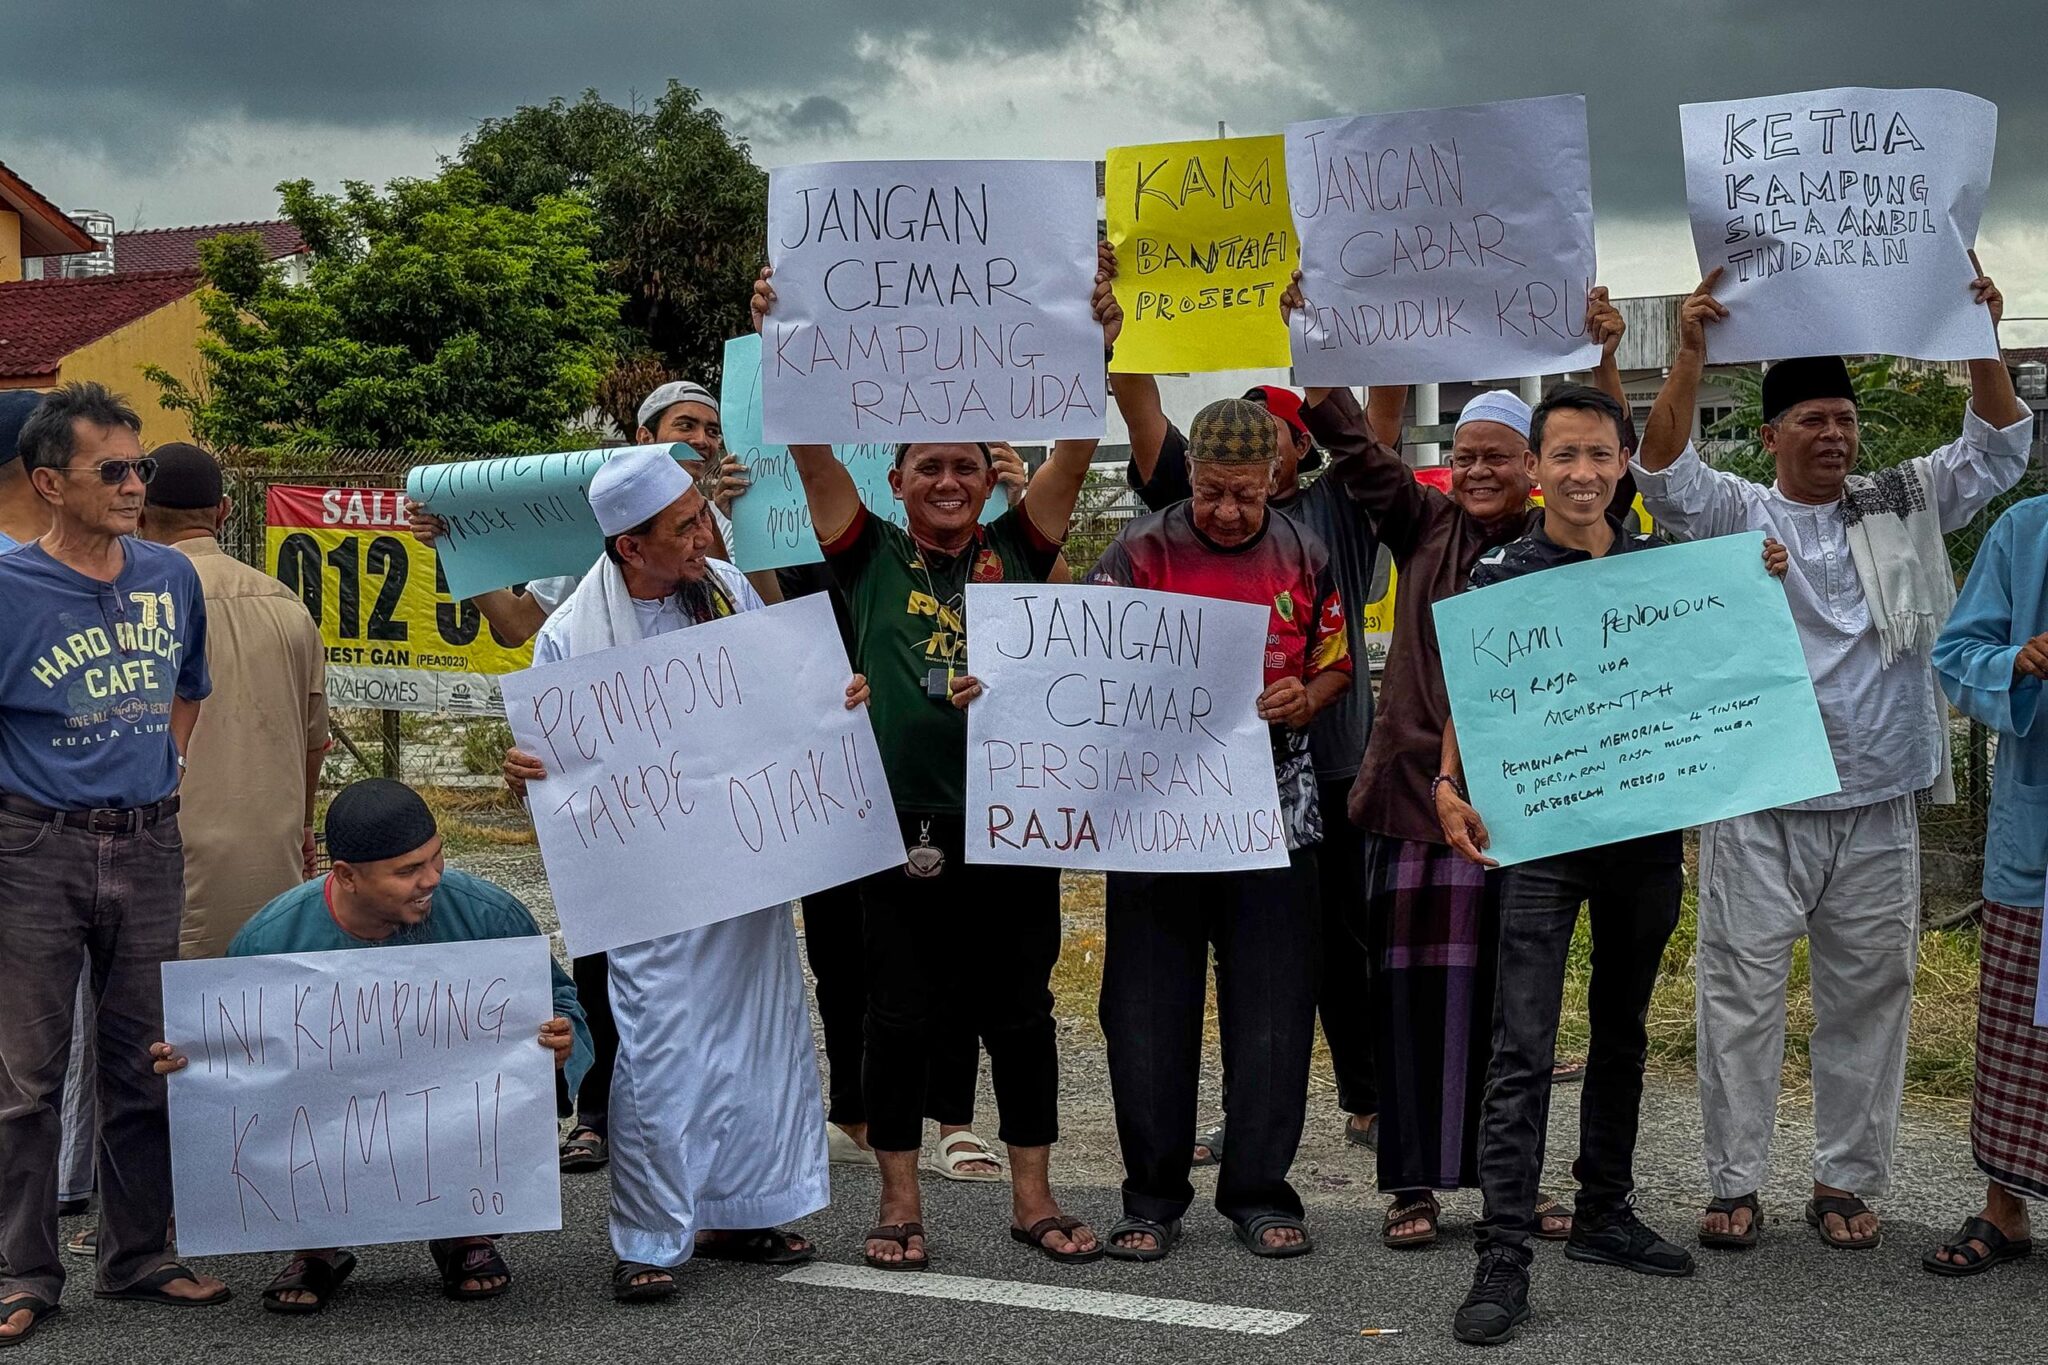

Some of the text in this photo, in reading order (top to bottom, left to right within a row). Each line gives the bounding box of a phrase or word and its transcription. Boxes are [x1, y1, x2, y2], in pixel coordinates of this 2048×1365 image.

[1722, 108, 1926, 166] KETUA
[1294, 130, 1464, 219] JANGAN
[1724, 170, 1929, 210] KAMPUNG
[780, 183, 989, 250] JANGAN
[1724, 205, 1937, 244] SILA AMBIL
[1136, 231, 1287, 275] BANTAH
[1339, 213, 1527, 278] CABAR
[1727, 238, 1910, 283] TINDAKAN
[823, 257, 1032, 312] CEMAR
[1136, 282, 1275, 322] PROJECT
[1302, 276, 1592, 354] PENDUDUK KRU
[776, 322, 1045, 378] KAMPUNG
[851, 372, 1098, 430] RAJA UDA
[767, 499, 812, 550] proje
[129, 591, 176, 631] 71
[276, 533, 409, 641] 012
[30, 626, 112, 690] HARD
[996, 595, 1203, 670] JANGAN
[1471, 593, 1726, 668] KAMI PENDUDUK
[84, 658, 159, 699] CAFE
[370, 648, 410, 666] GAN
[416, 654, 469, 670] (PEA3023)
[1530, 671, 1579, 696] RAJA
[1046, 673, 1228, 748] CEMAR
[1543, 681, 1675, 728] MEMBANTAH
[52, 729, 121, 748] KUALA
[1502, 745, 1589, 780] PEMBINAAN
[1600, 721, 1674, 750] MEMORIAL
[983, 740, 1232, 796] PERSIARAN
[1516, 782, 1526, 796] DI
[1534, 761, 1606, 795] PERSIARAN
[987, 804, 1100, 851] RAJA
[202, 978, 511, 1079] INI KAMPUNG
